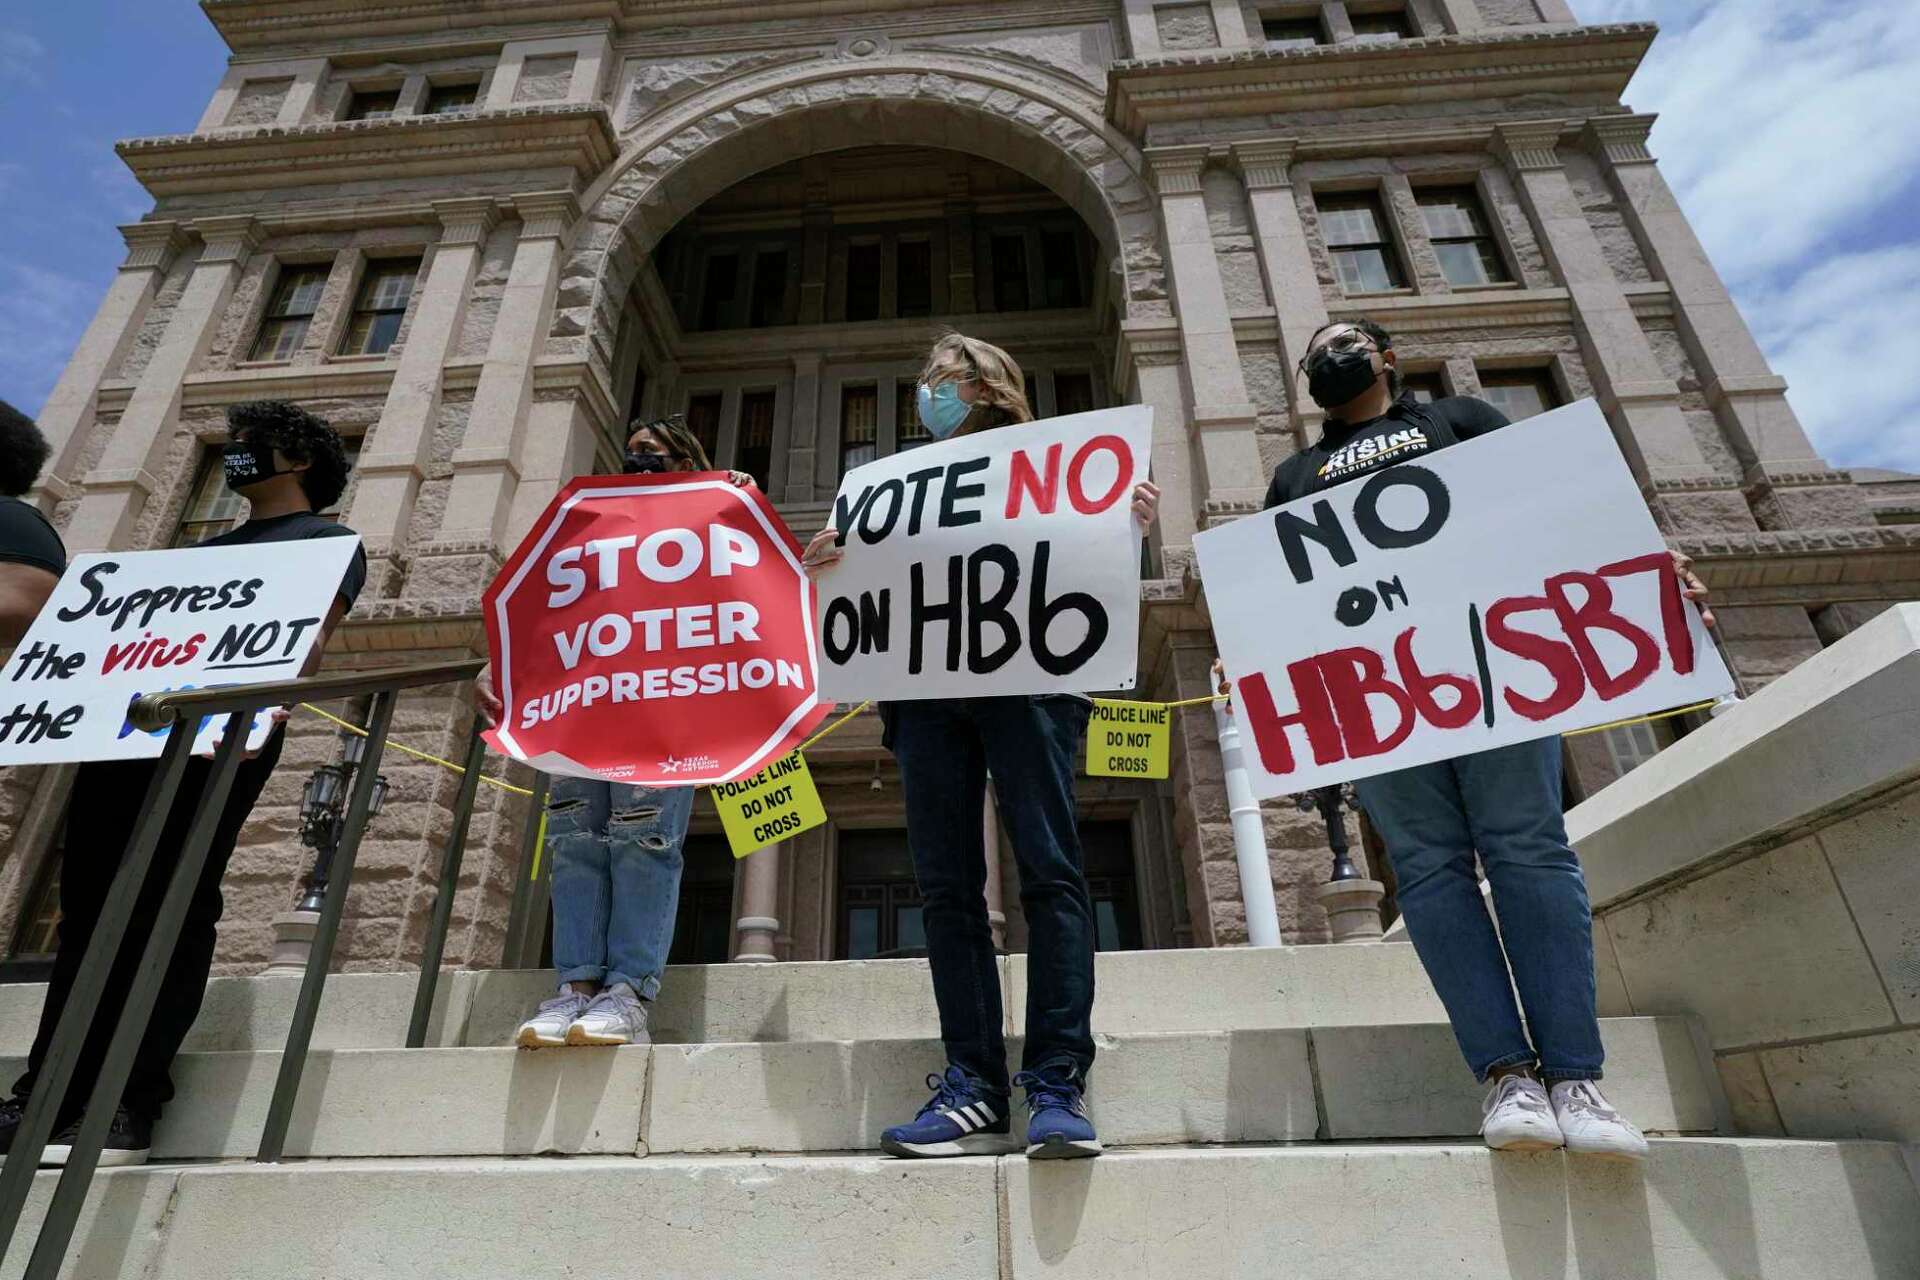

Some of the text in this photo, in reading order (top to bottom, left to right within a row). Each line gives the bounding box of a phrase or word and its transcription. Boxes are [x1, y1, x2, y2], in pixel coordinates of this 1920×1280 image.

[835, 434, 1134, 547] VOTE NO
[1325, 459, 1373, 480] BUILDING
[1378, 450, 1400, 463] OUR
[1274, 464, 1451, 584] NO
[546, 523, 760, 608] STOP
[57, 562, 264, 632] Suppress
[823, 541, 1109, 676] ON HB6
[1335, 575, 1409, 627] ON
[11, 617, 320, 681] the virus NOT
[554, 601, 760, 671] VOTER
[520, 659, 805, 730] SUPPRESSION
[1093, 706, 1166, 724] POLICE LINE
[0, 700, 84, 744] the
[1107, 731, 1152, 748] DO NOT
[715, 754, 801, 801] POLICE LINE
[1108, 757, 1148, 773] CROSS
[741, 786, 793, 819] DO NOT
[754, 811, 801, 842] CROSS
